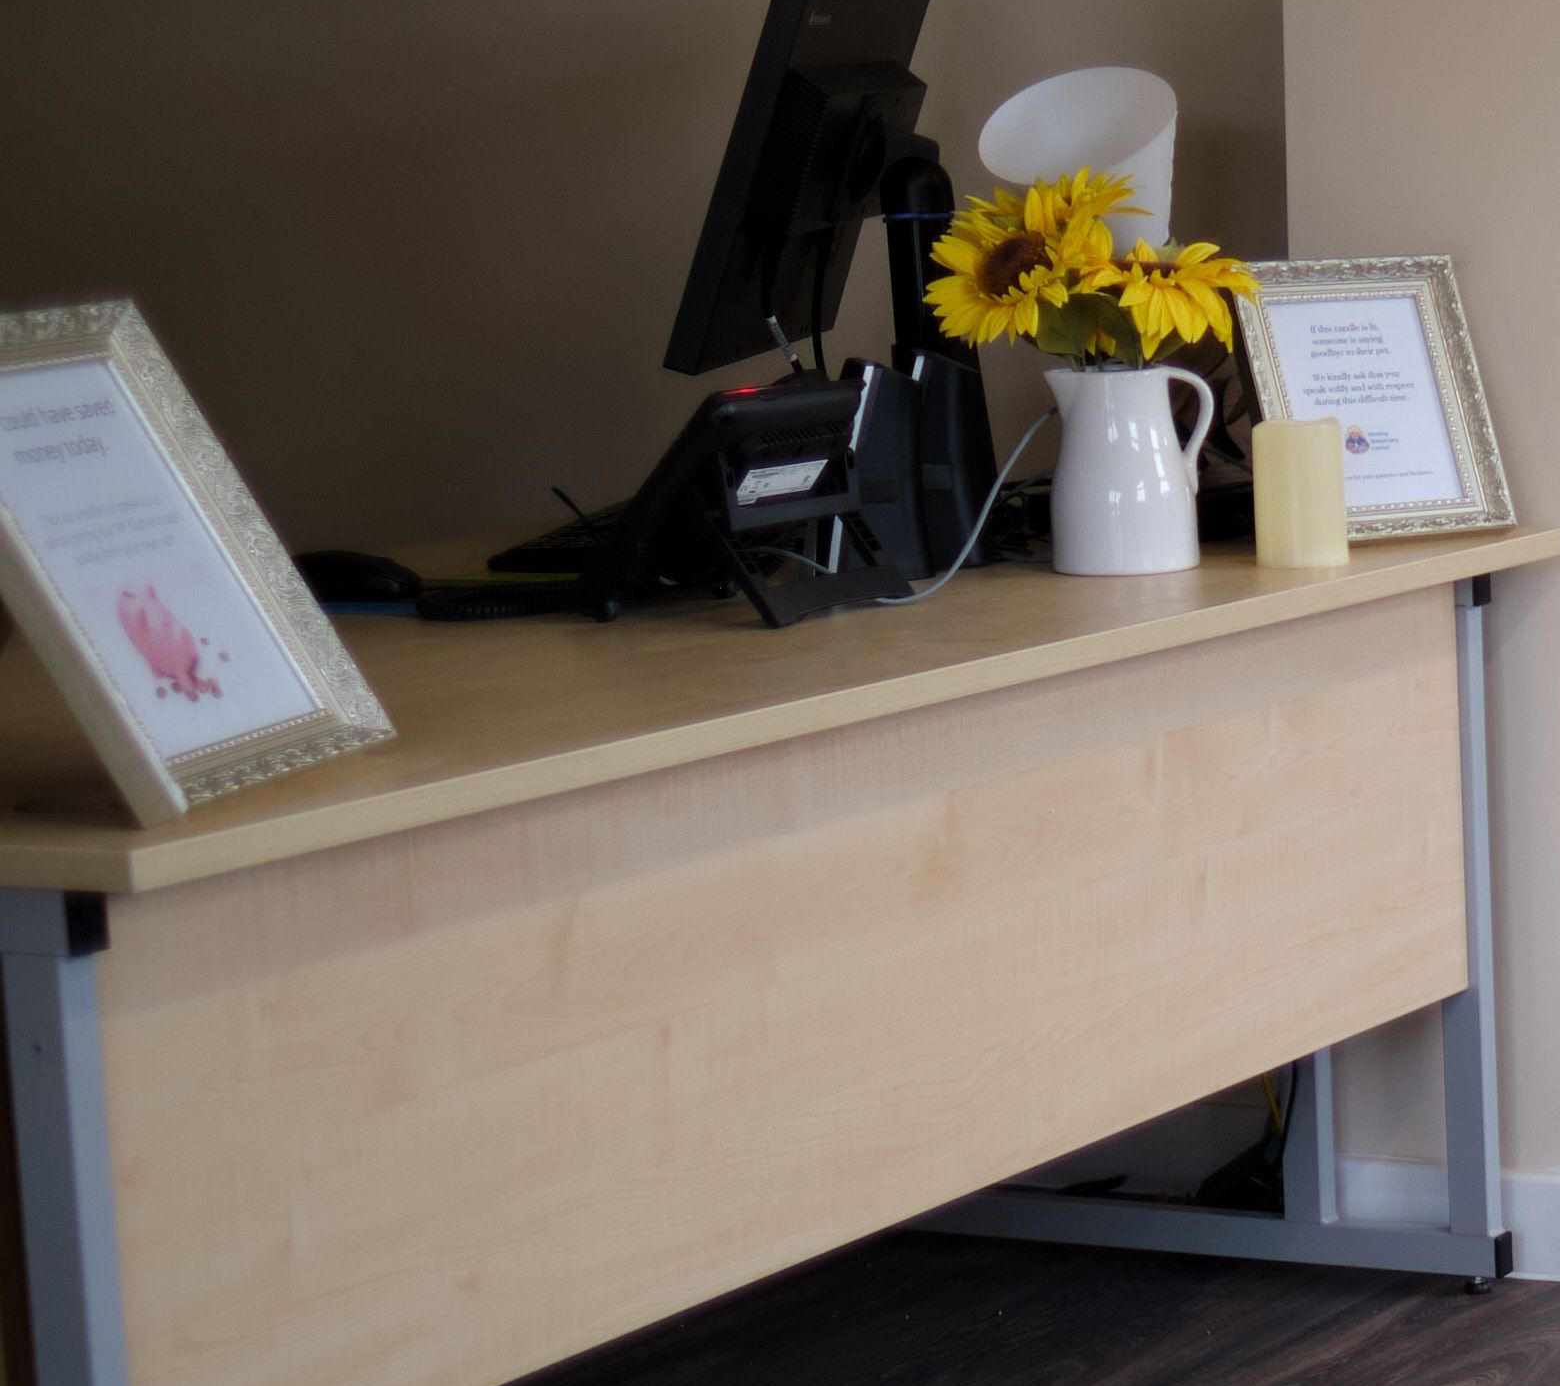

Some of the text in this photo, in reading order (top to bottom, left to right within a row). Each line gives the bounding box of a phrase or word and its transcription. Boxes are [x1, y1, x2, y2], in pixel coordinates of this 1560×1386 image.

[1317, 324, 1332, 333] this
[1333, 323, 1359, 332] candle
[1358, 336, 1383, 344] saying
[1310, 349, 1345, 358] goodbye
[1327, 372, 1351, 381] kindly
[1353, 371, 1366, 380] ask
[1367, 371, 1384, 379] that
[1384, 371, 1400, 379] you
[1303, 382, 1414, 396] speak softly and with respect
[1313, 397, 1341, 406] during
[1342, 396, 1357, 404] this
